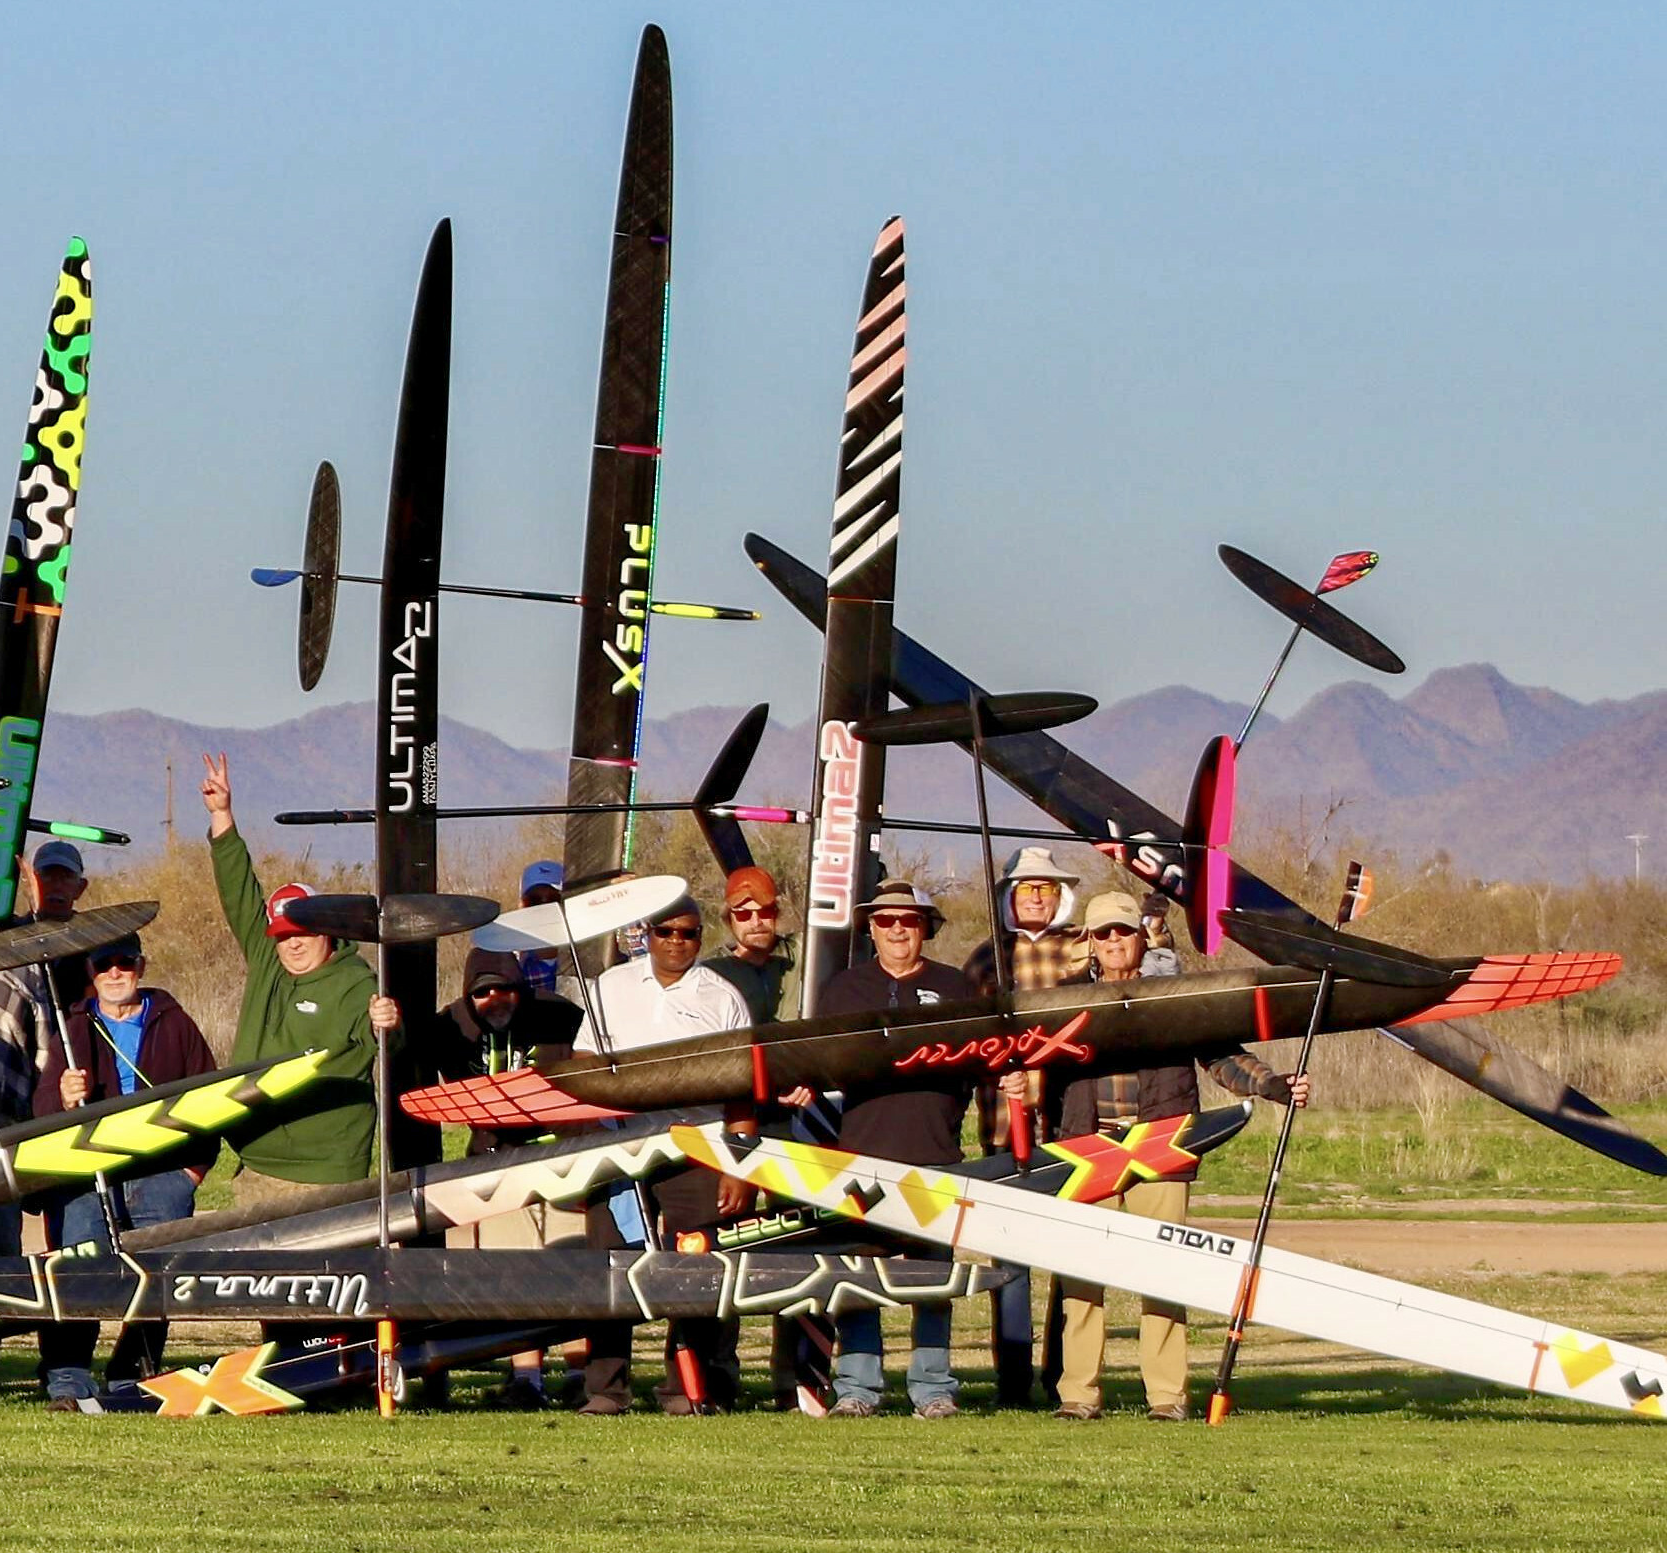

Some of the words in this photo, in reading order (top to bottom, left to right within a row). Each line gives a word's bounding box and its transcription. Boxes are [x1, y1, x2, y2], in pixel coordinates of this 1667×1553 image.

[605, 523, 653, 695] PLUSX
[895, 1010, 1091, 1070] Xplorer
[173, 1276, 195, 1301] 2
[197, 1271, 370, 1318] Ultima
